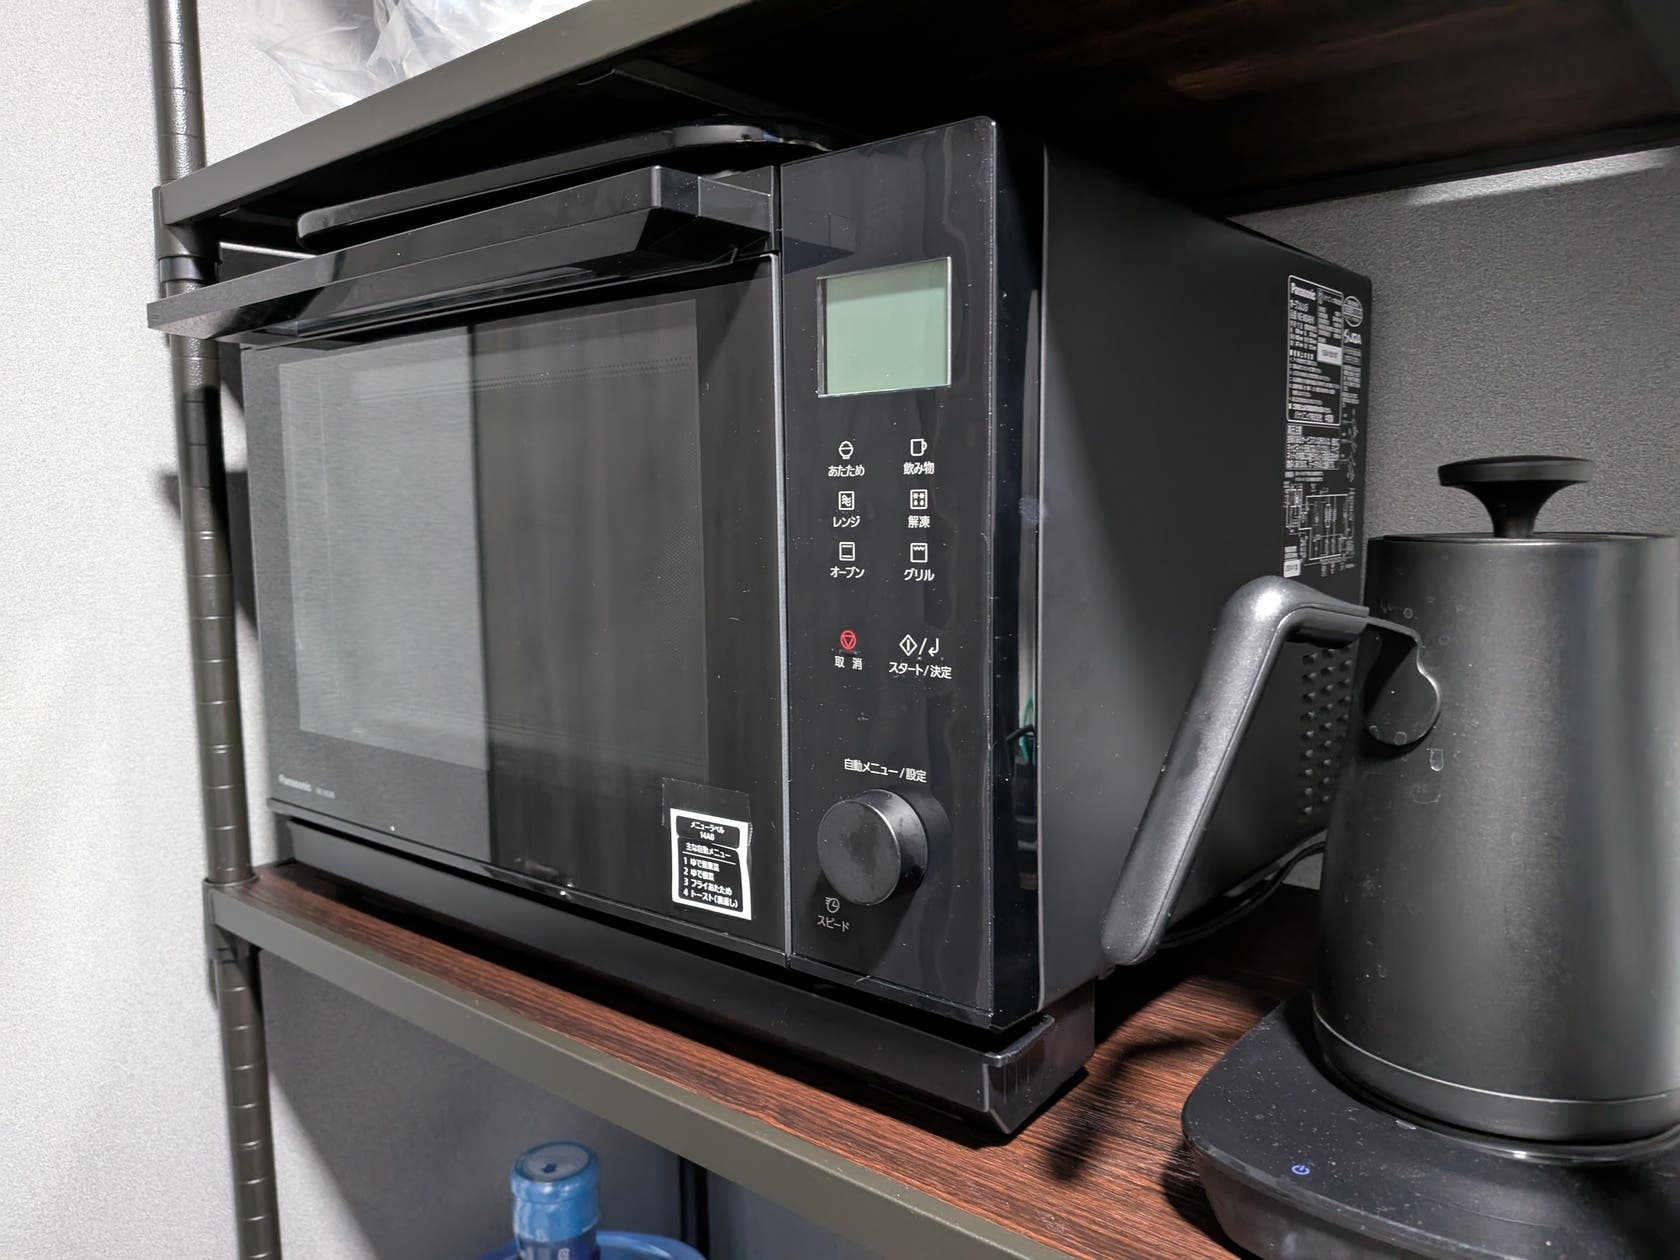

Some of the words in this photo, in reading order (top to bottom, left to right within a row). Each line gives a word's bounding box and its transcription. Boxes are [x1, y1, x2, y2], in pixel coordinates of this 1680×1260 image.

[828, 465, 865, 478] あたため
[903, 462, 935, 476] 飲み物
[832, 515, 861, 528] レンジ
[907, 515, 931, 529] 解凍
[830, 566, 865, 579] オーブン
[903, 568, 935, 582] グリル
[888, 661, 953, 680] スタート/決定
[844, 758, 928, 783] 自動メニュー/設定
[683, 857, 688, 865] 1
[683, 867, 689, 875] 2
[683, 877, 689, 886] 3
[690, 879, 733, 896] フライあたため
[683, 888, 688, 897] 4
[816, 915, 850, 932] スピード
